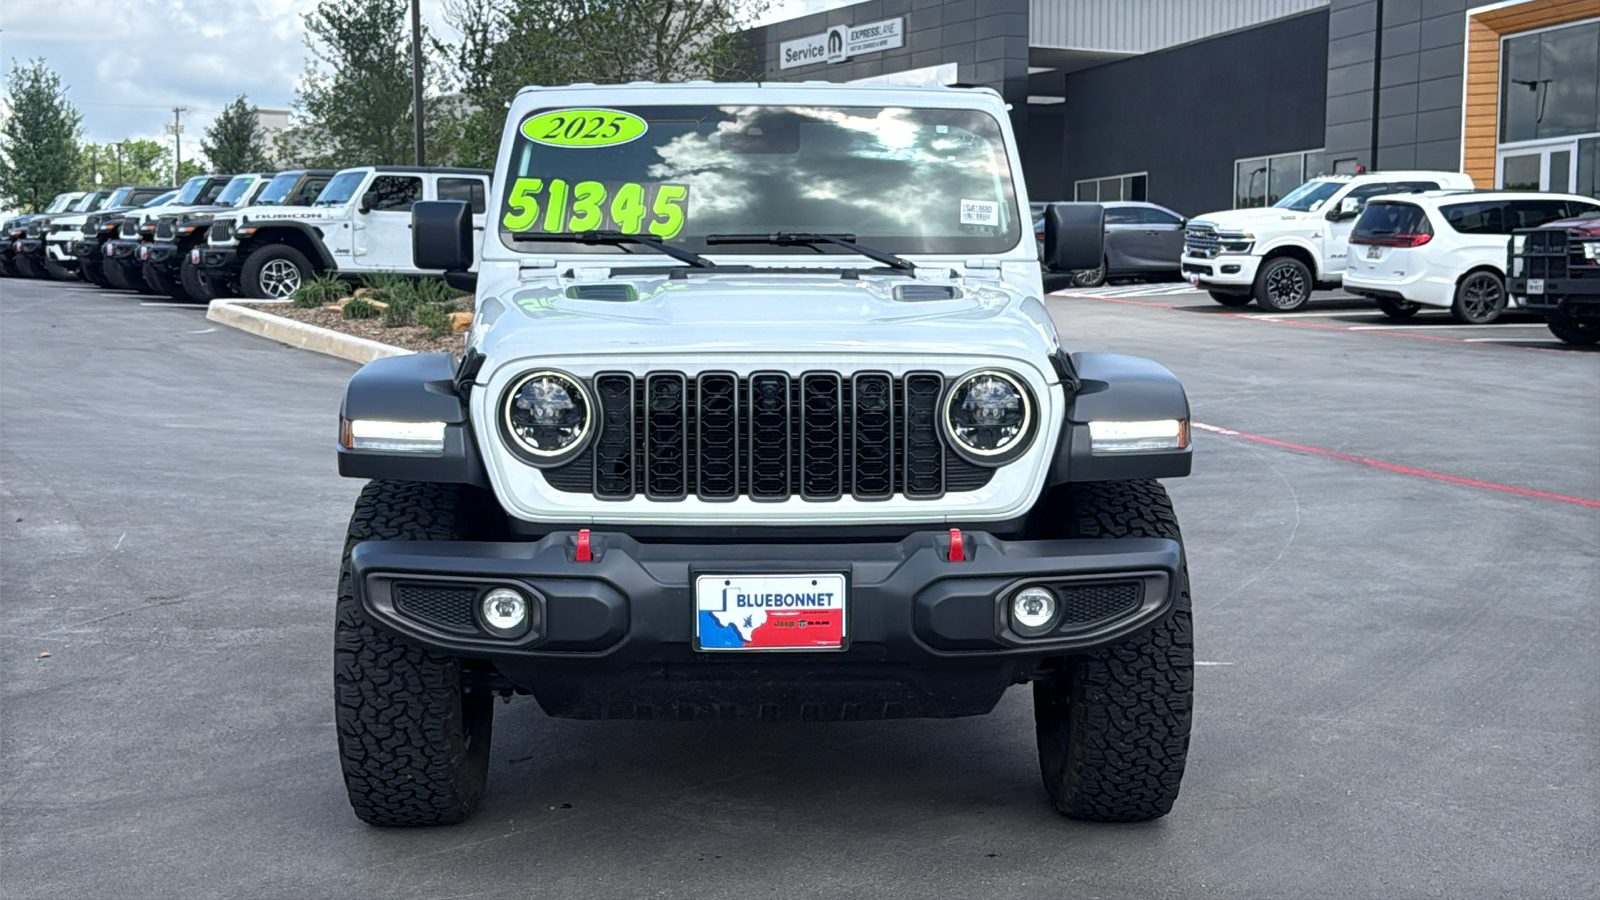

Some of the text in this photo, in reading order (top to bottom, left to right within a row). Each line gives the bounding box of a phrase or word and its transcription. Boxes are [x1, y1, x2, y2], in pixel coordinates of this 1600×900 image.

[785, 44, 824, 63] Service
[542, 116, 628, 140] 2025
[503, 178, 687, 240] 51345
[736, 592, 834, 608] BLUEBONNET
